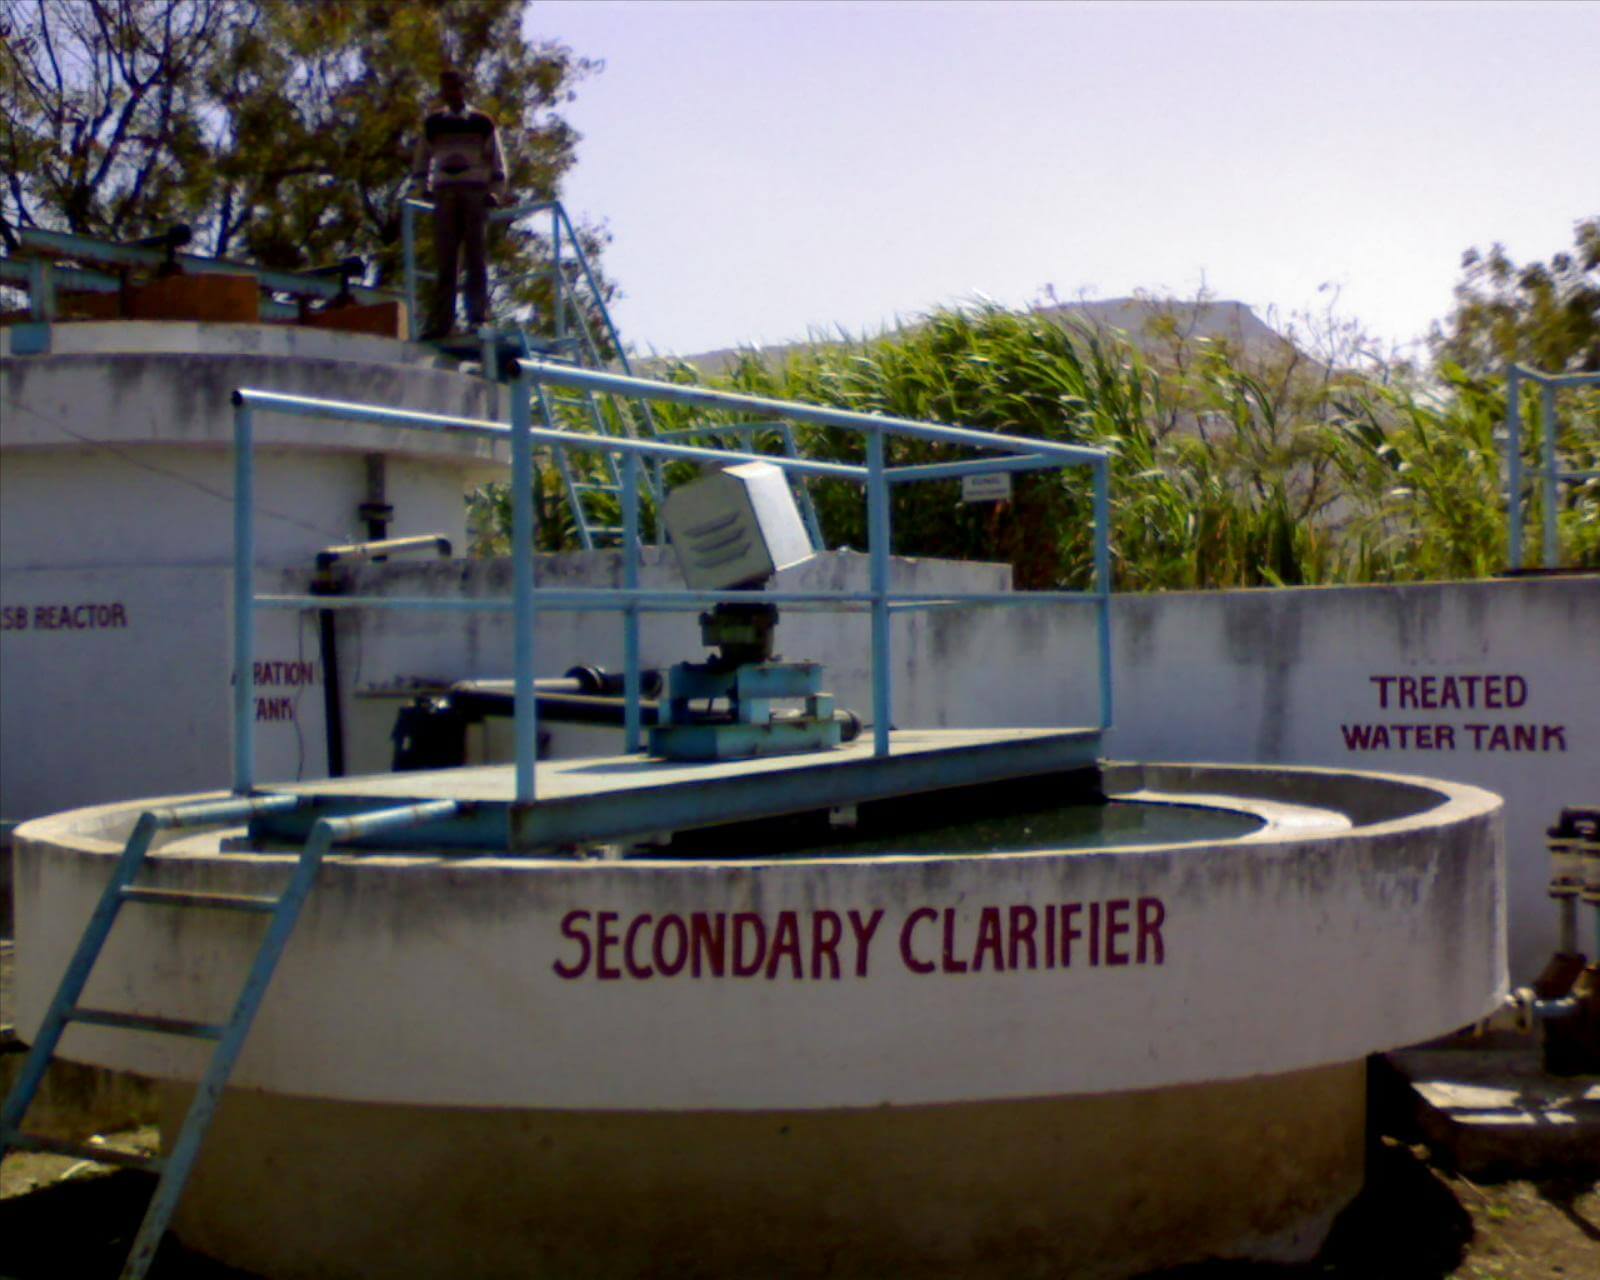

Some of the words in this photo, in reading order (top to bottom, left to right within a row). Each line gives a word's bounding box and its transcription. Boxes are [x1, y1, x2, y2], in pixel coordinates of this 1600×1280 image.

[34, 603, 128, 629] REACTOR
[1370, 674, 1528, 710] TREATED
[254, 697, 292, 720] ANK
[1341, 724, 1456, 751] WATER
[1464, 724, 1567, 751] TANK
[553, 908, 885, 980] SECONDARY
[899, 896, 1166, 974] CLARIFIER
